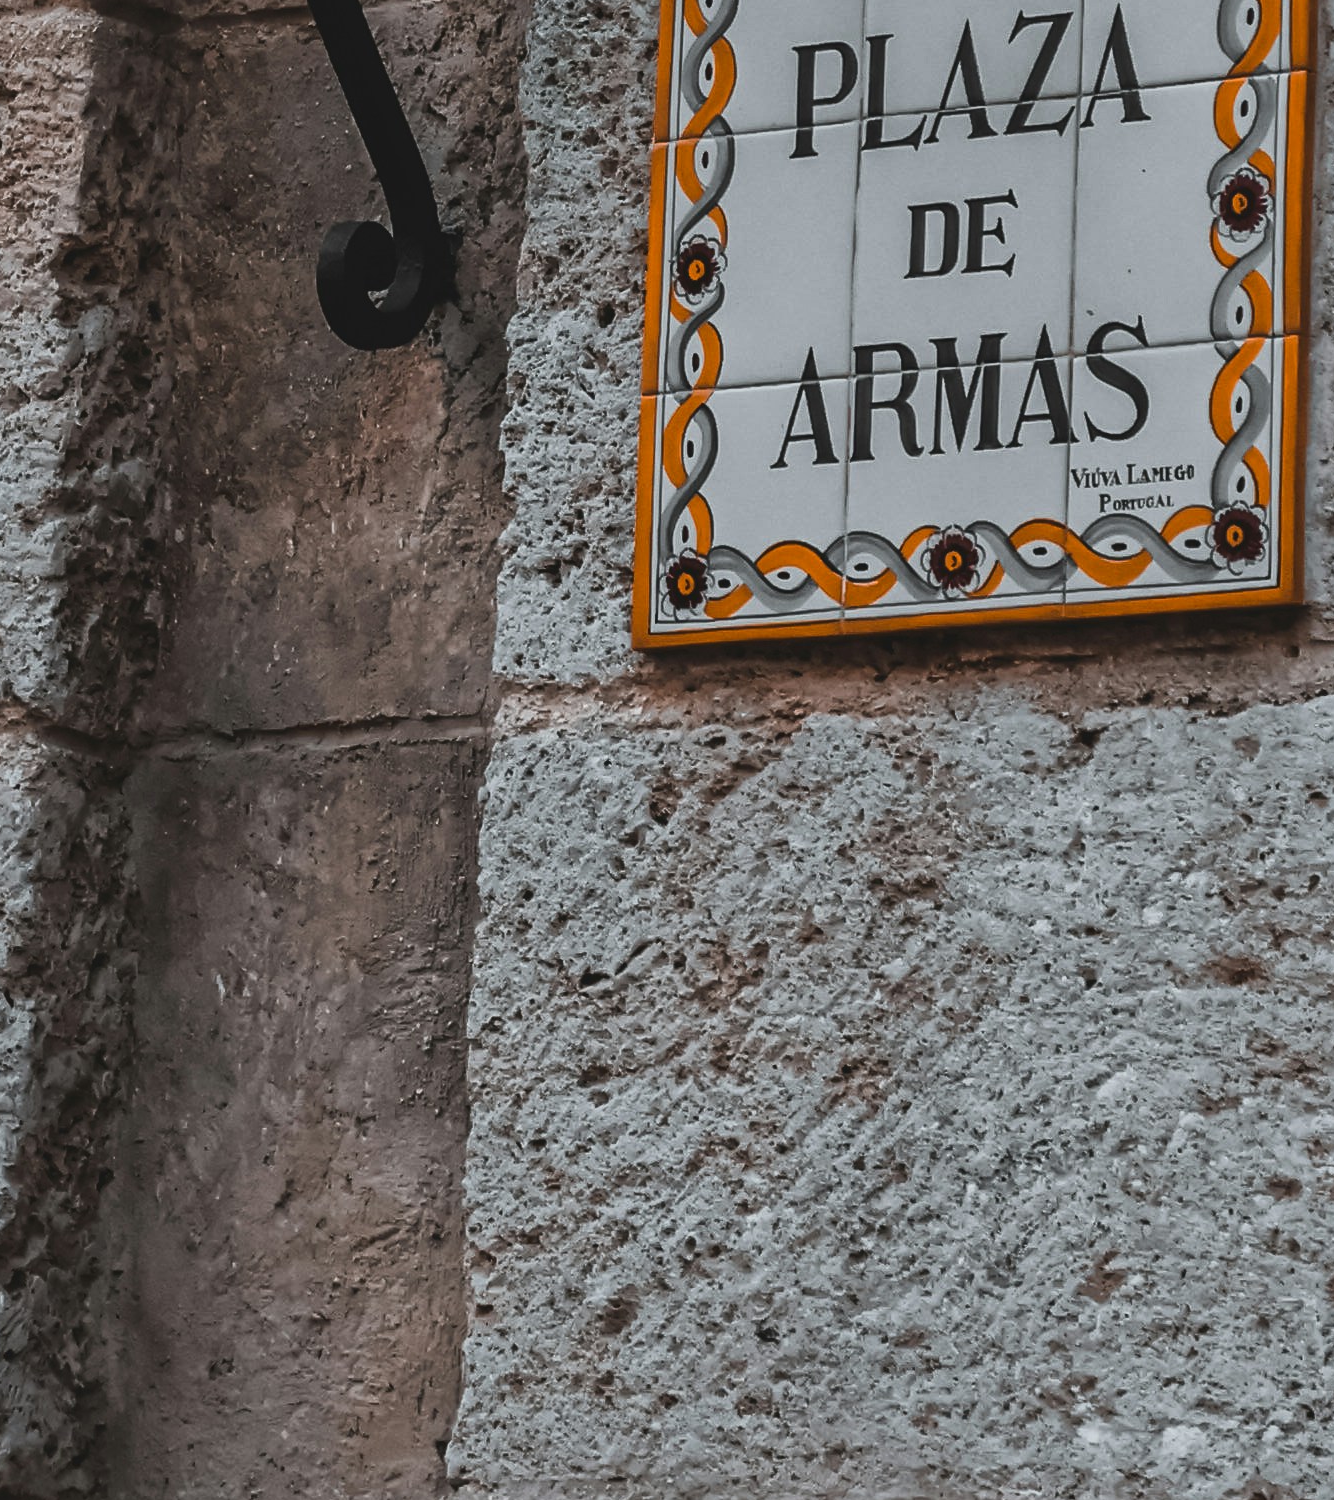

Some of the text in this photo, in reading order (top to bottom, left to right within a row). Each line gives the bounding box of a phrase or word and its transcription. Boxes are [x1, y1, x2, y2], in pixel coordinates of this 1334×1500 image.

[789, 3, 1150, 159] PLAZA
[904, 189, 1019, 280] DE
[770, 315, 1150, 469] ARMAS
[1099, 494, 1174, 513] PORTUGAL
